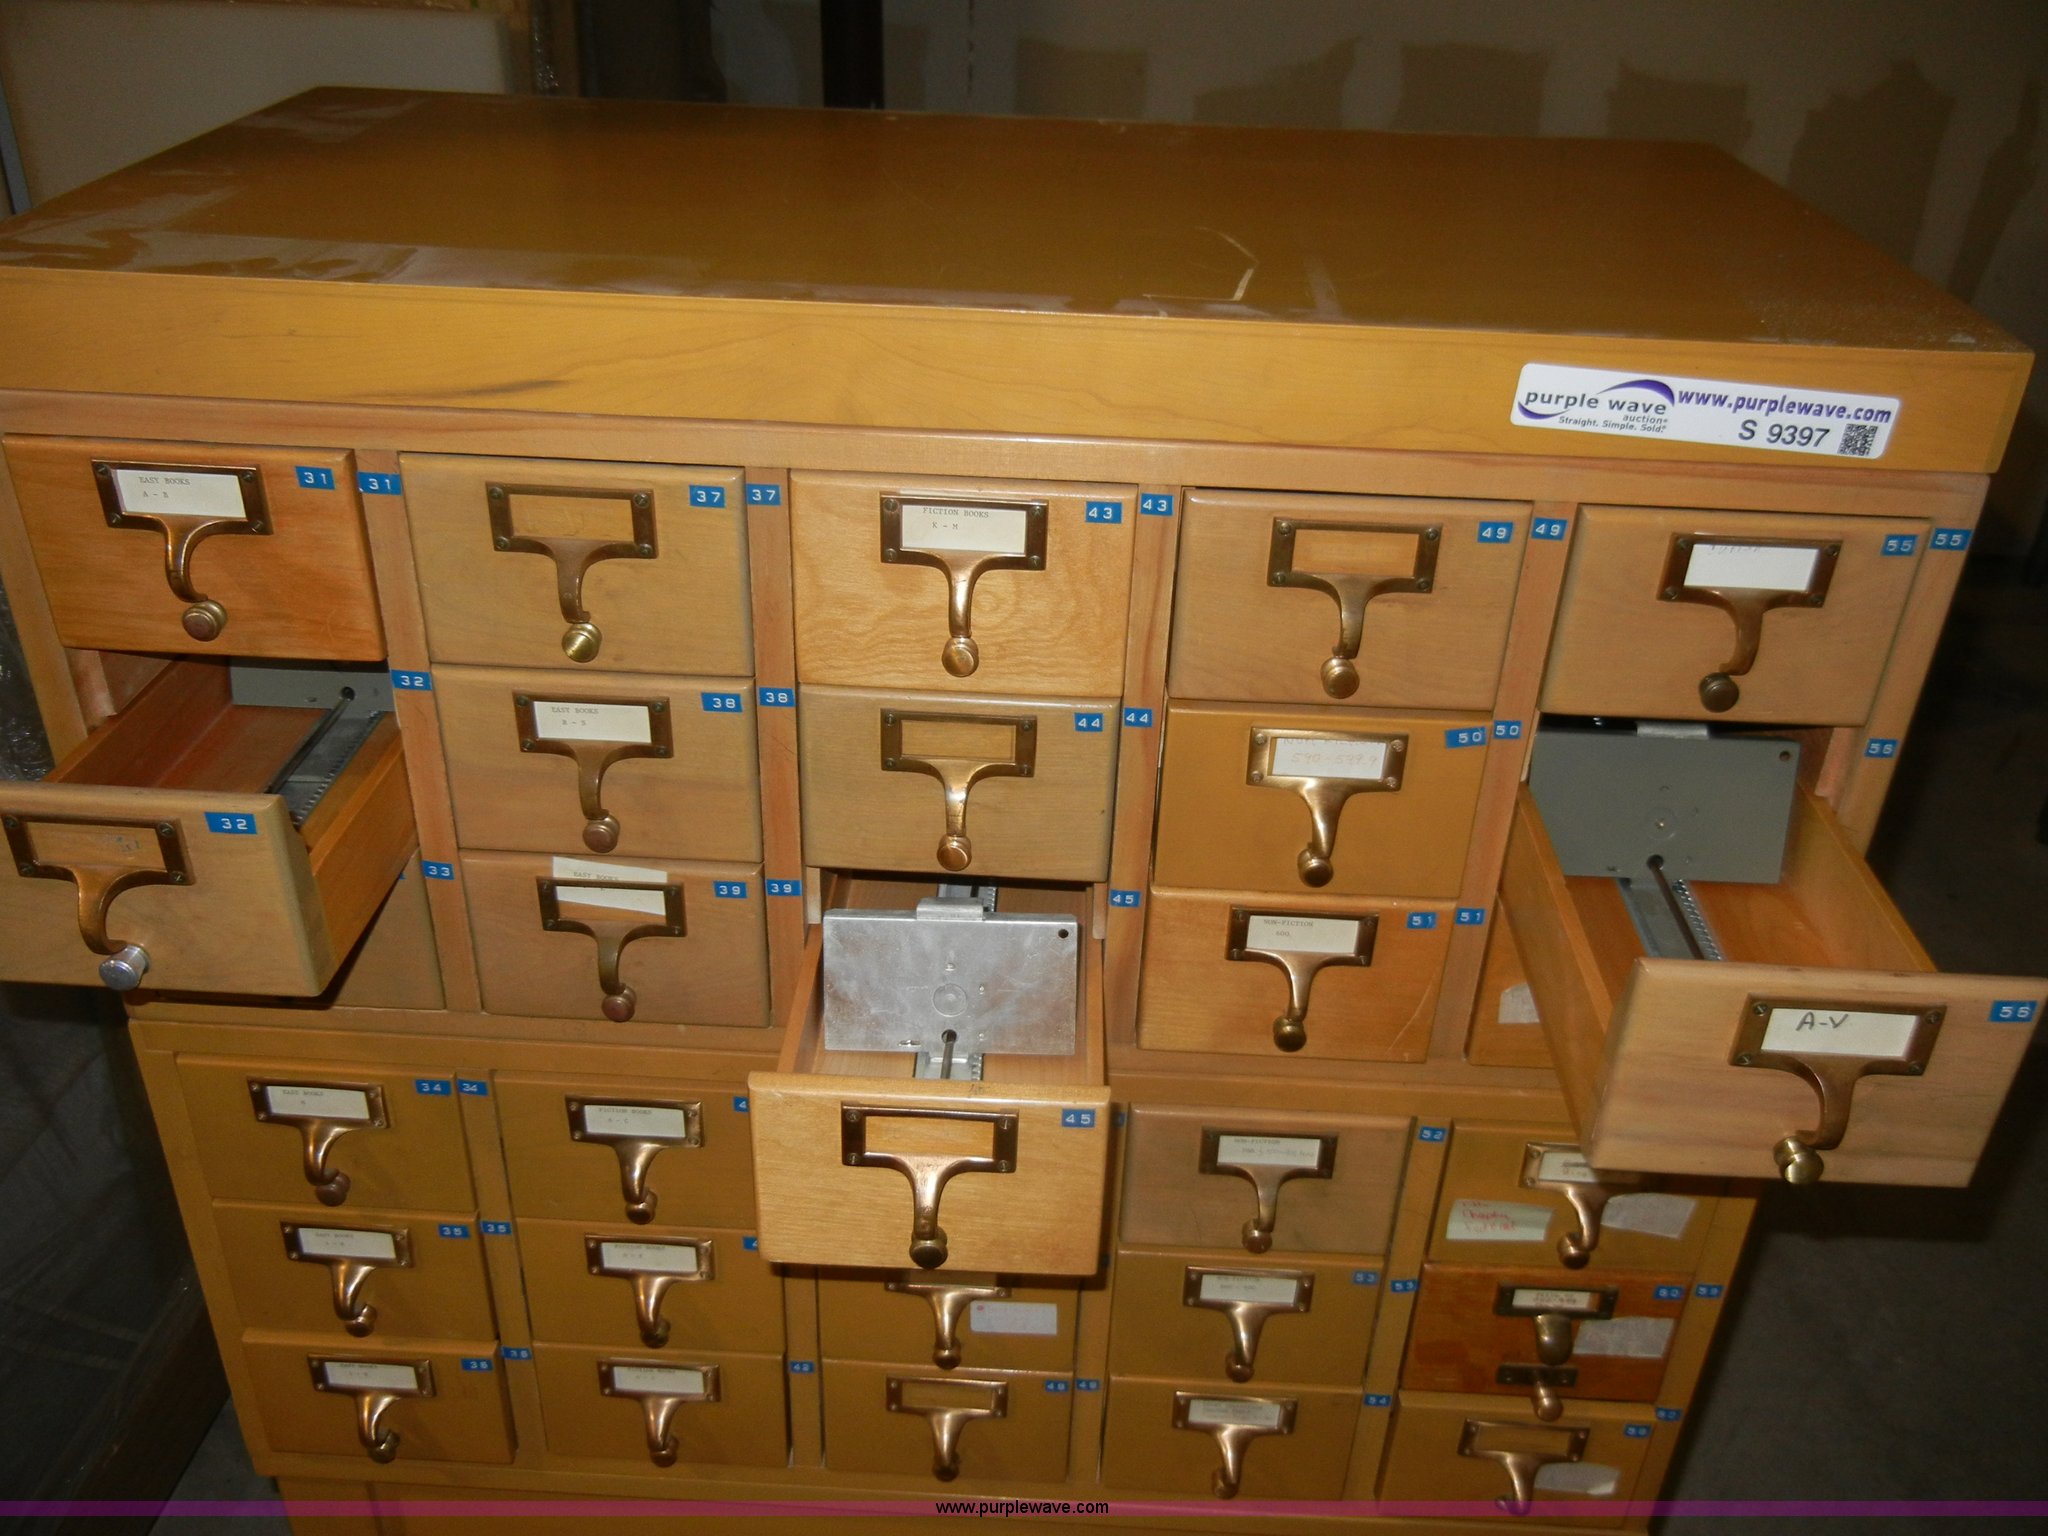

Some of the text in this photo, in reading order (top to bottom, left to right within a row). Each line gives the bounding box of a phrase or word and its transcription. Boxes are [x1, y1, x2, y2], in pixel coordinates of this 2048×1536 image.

[1525, 389, 1667, 415] purple wave
[1678, 388, 1892, 424] www.purplewave.com
[1558, 416, 1599, 428] Straight.
[1602, 419, 1637, 431] Simple.
[1739, 419, 1830, 447] S 9397
[138, 476, 190, 486] EASY BOOKS
[304, 471, 328, 485] 31
[368, 478, 391, 490] 31
[697, 490, 720, 503] 37
[752, 489, 776, 501] 37
[1142, 499, 1167, 512] 43
[922, 507, 989, 518] FICTION BOOKS
[1088, 507, 1112, 520] 43
[1482, 527, 1507, 539] 49
[1535, 523, 1560, 536] 49
[1935, 533, 1962, 546] 55
[1886, 540, 1913, 552] 55
[400, 675, 423, 687] 32
[713, 697, 736, 709] 38
[766, 692, 788, 703] 38
[1077, 717, 1101, 728] 44
[1125, 713, 1149, 723] 44
[1495, 725, 1518, 736] 50
[1458, 731, 1482, 743] 50
[221, 817, 248, 830] 32
[429, 865, 451, 877] 33
[719, 885, 741, 896] 39
[771, 883, 792, 893] 39
[1112, 894, 1134, 904] 45
[1412, 915, 1432, 926] 51
[1460, 911, 1481, 922] 51
[1999, 1006, 2030, 1018] 56
[422, 1083, 442, 1092] 34
[462, 1082, 478, 1092] 34
[1065, 1113, 1090, 1125] 45
[1421, 1129, 1443, 1140] 52
